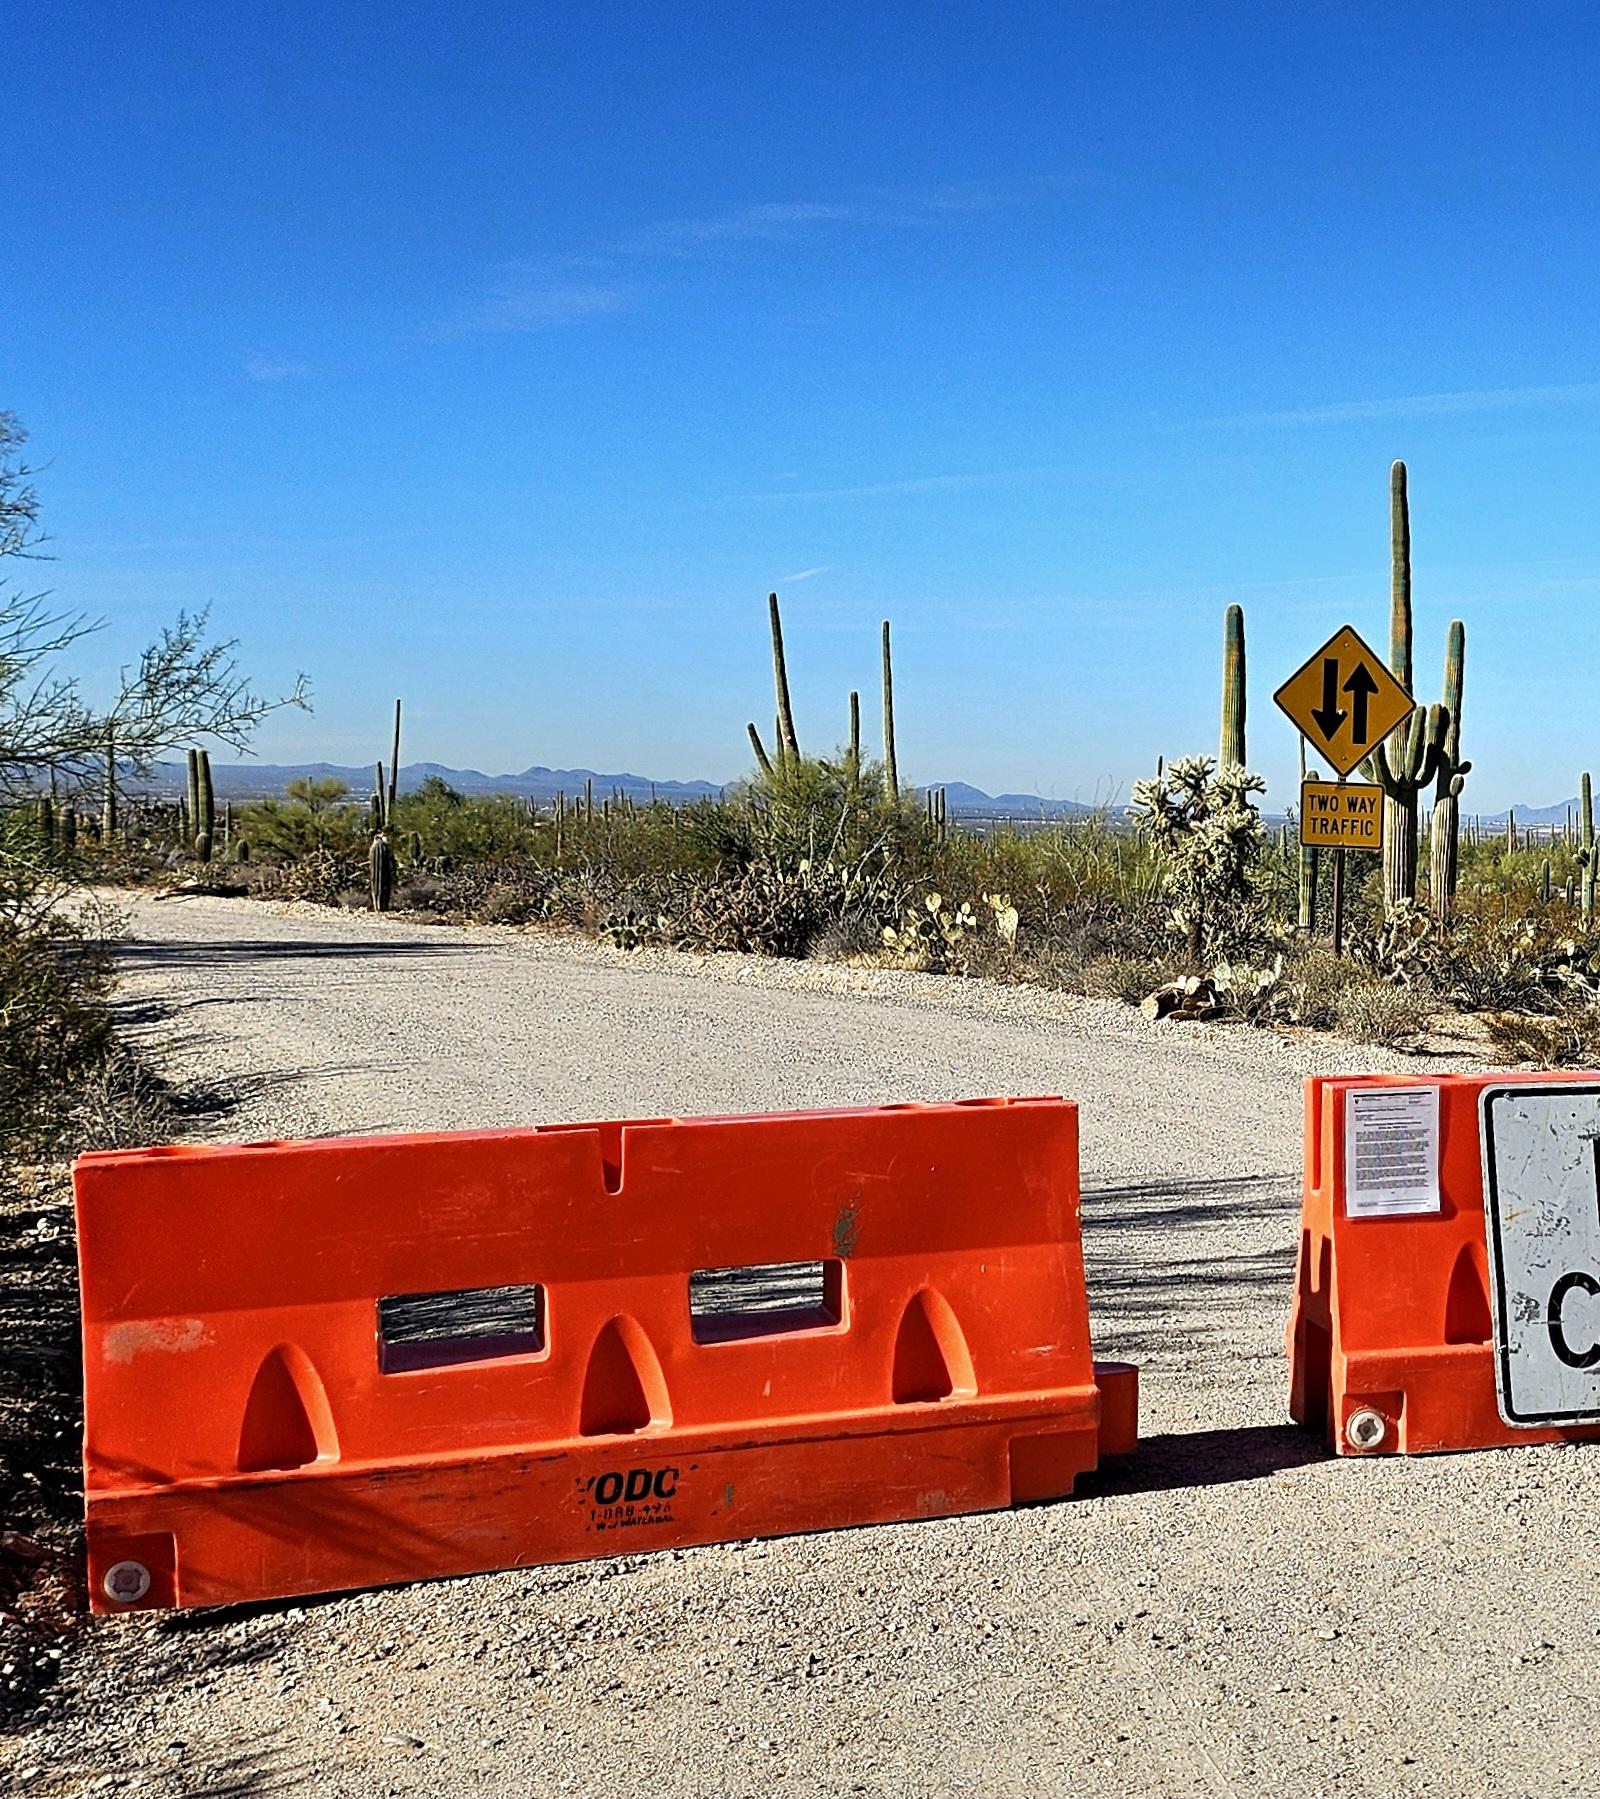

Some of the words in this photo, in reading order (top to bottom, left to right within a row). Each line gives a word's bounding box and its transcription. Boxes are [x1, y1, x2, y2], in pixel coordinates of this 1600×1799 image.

[1308, 794, 1339, 812] TWO
[1346, 796, 1377, 814] WAY
[1310, 817, 1374, 836] TRAFFIC
